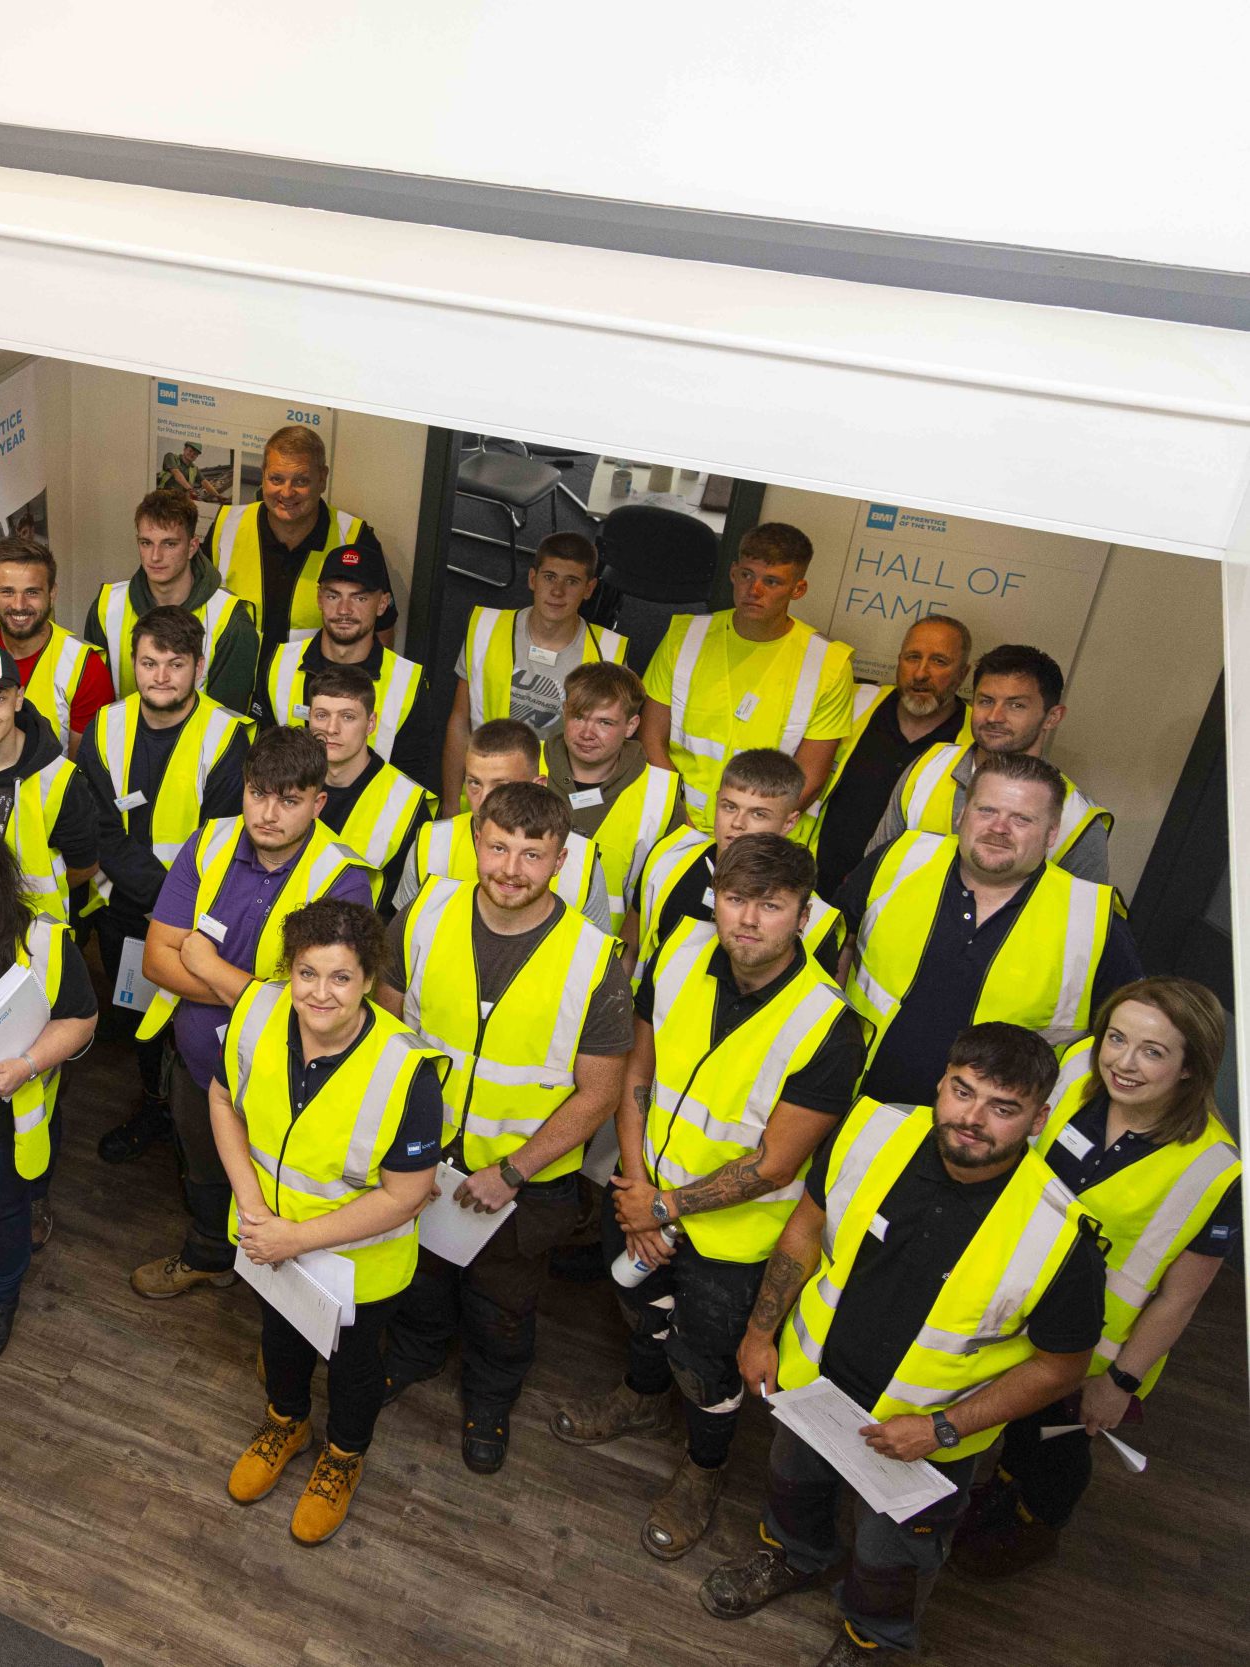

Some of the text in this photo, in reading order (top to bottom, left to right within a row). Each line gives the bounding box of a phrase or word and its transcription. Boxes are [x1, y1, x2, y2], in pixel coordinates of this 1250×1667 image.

[160, 389, 176, 399] BMI
[181, 391, 215, 401] APPRENTICE
[286, 409, 321, 425] 2018
[0, 427, 26, 458] YEAR
[871, 512, 894, 523] BMI
[901, 514, 947, 526] APPRENTICE
[855, 548, 1026, 597] HALL OF
[511, 691, 561, 711] NDERARMOU
